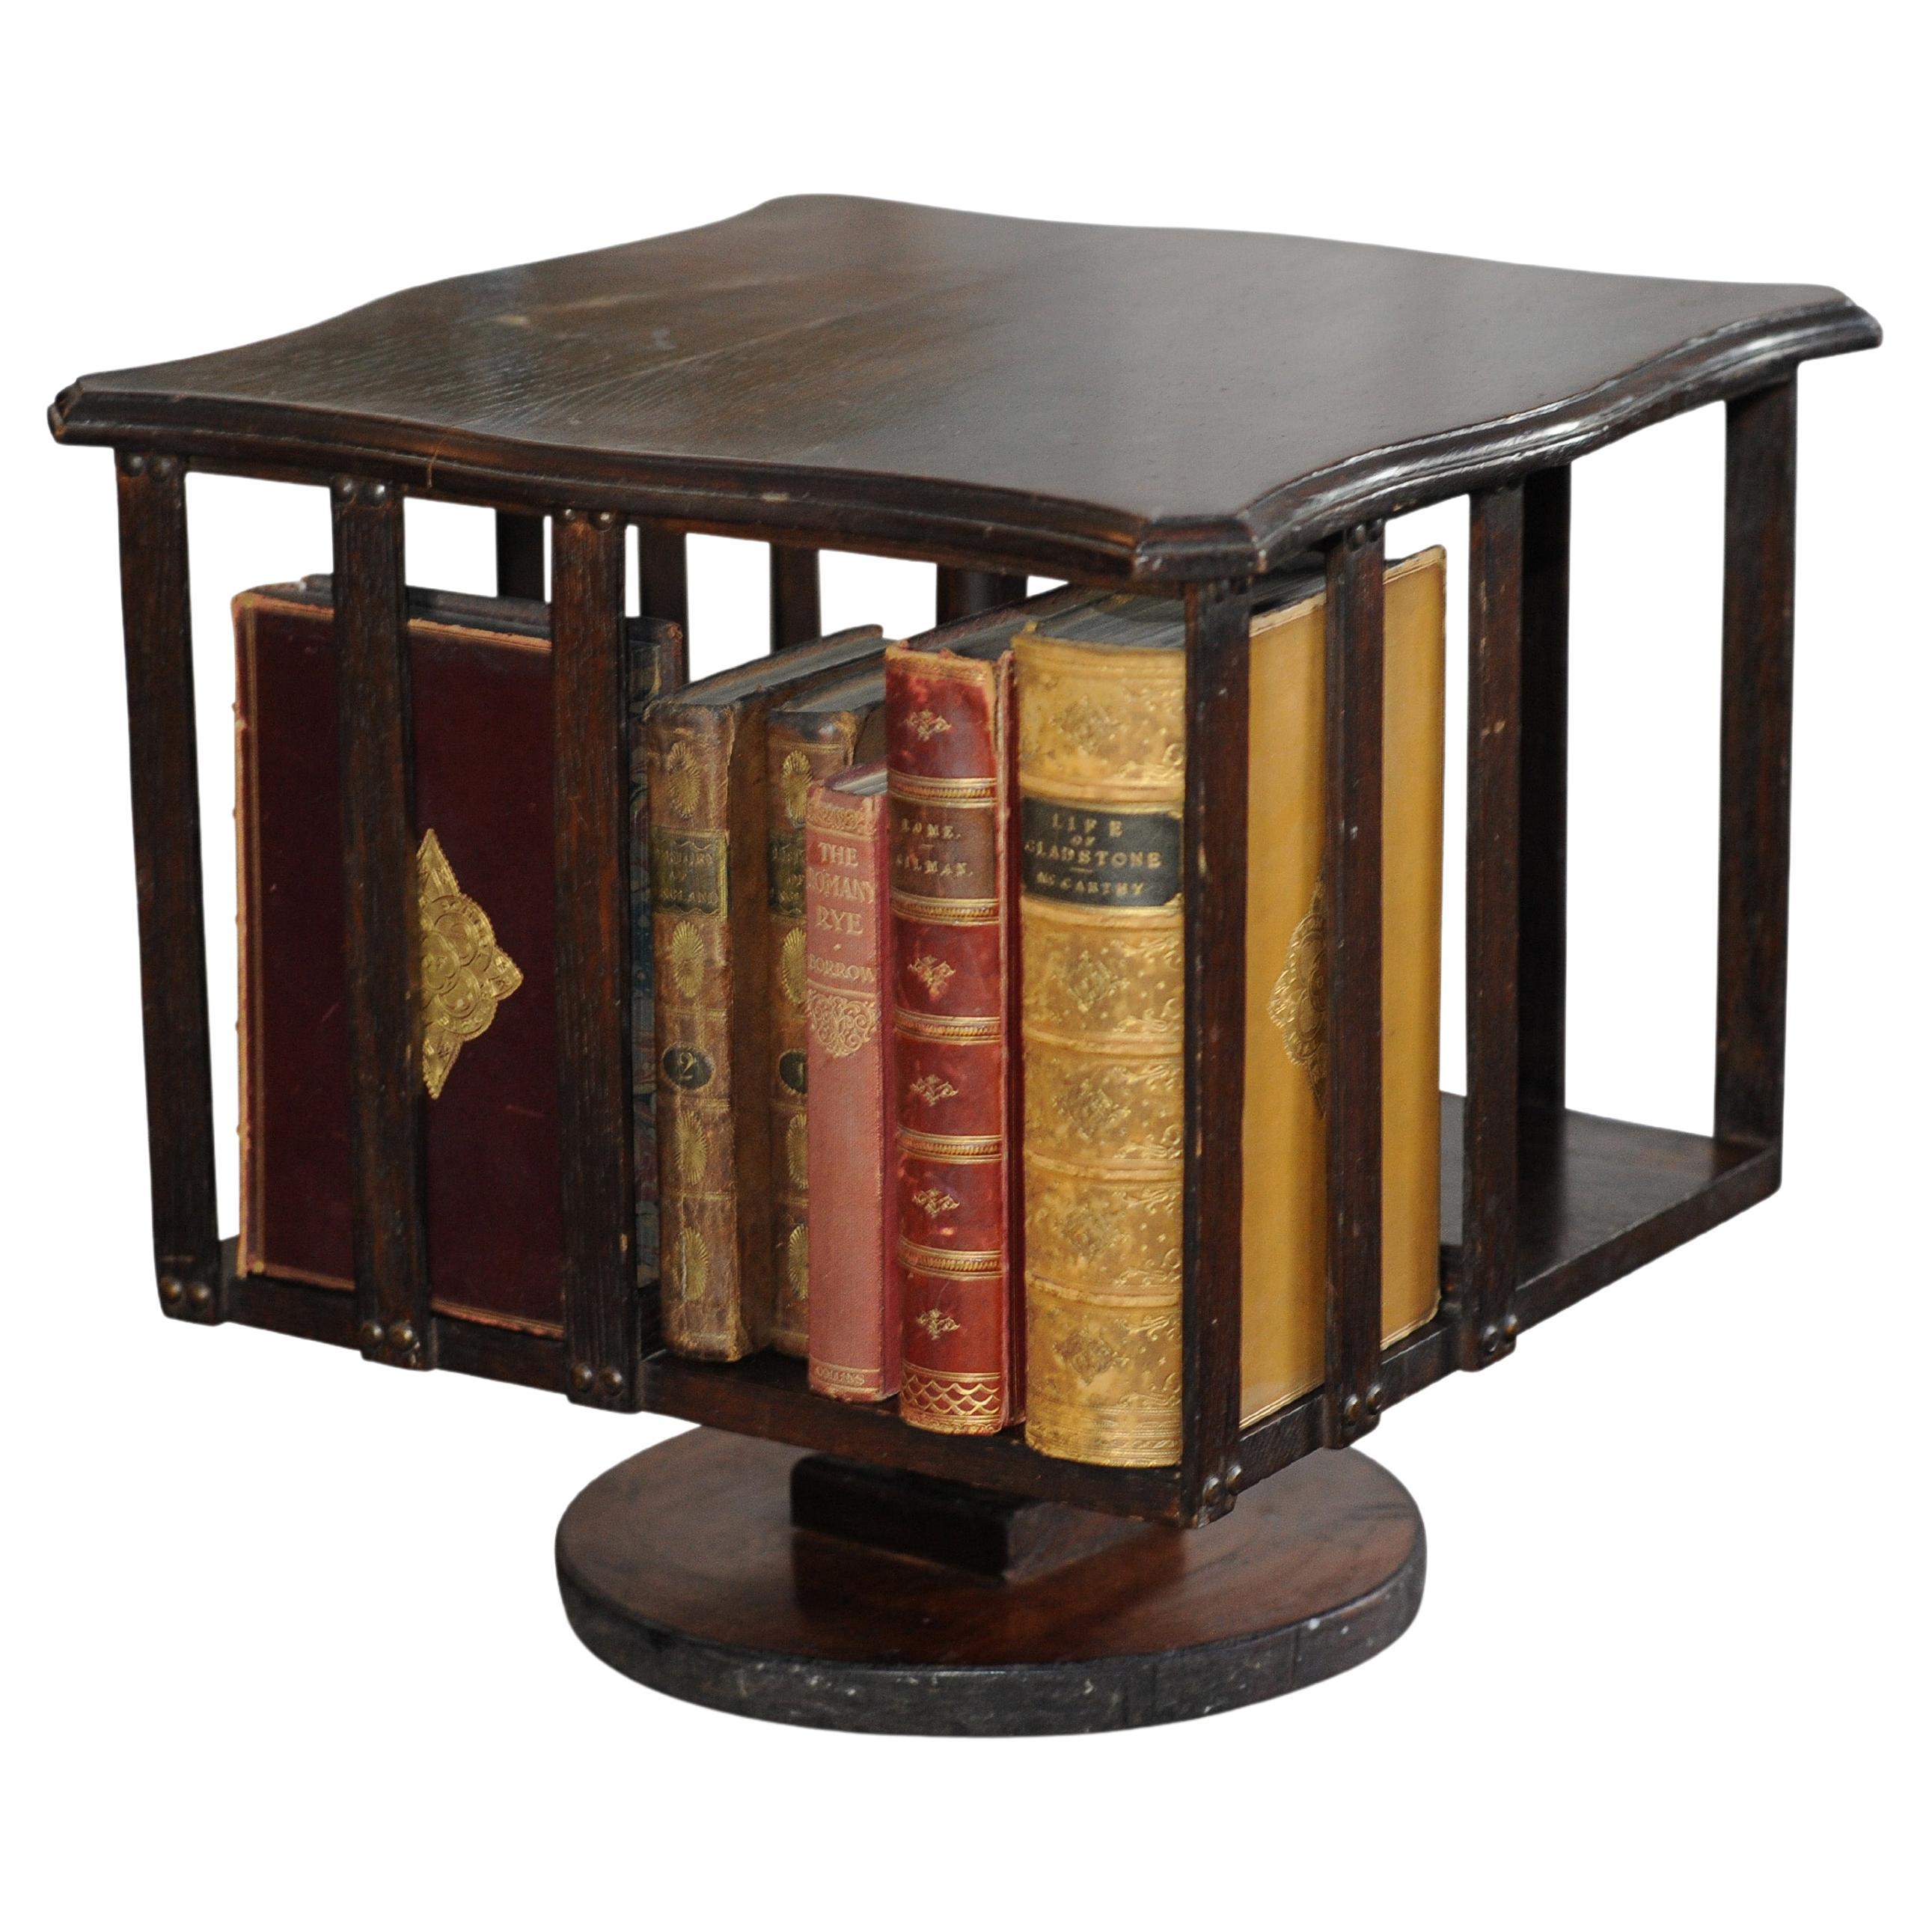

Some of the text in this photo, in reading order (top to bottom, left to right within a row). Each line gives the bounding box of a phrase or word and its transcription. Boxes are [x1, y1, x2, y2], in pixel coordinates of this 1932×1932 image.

[1052, 813, 1123, 838] LIFE
[817, 842, 860, 867] THE
[1024, 838, 1163, 870] GLADSTONE
[1069, 834, 1096, 848] OF
[814, 904, 865, 936] RYE
[807, 953, 876, 983] BORROW
[678, 1051, 695, 1081] 2
